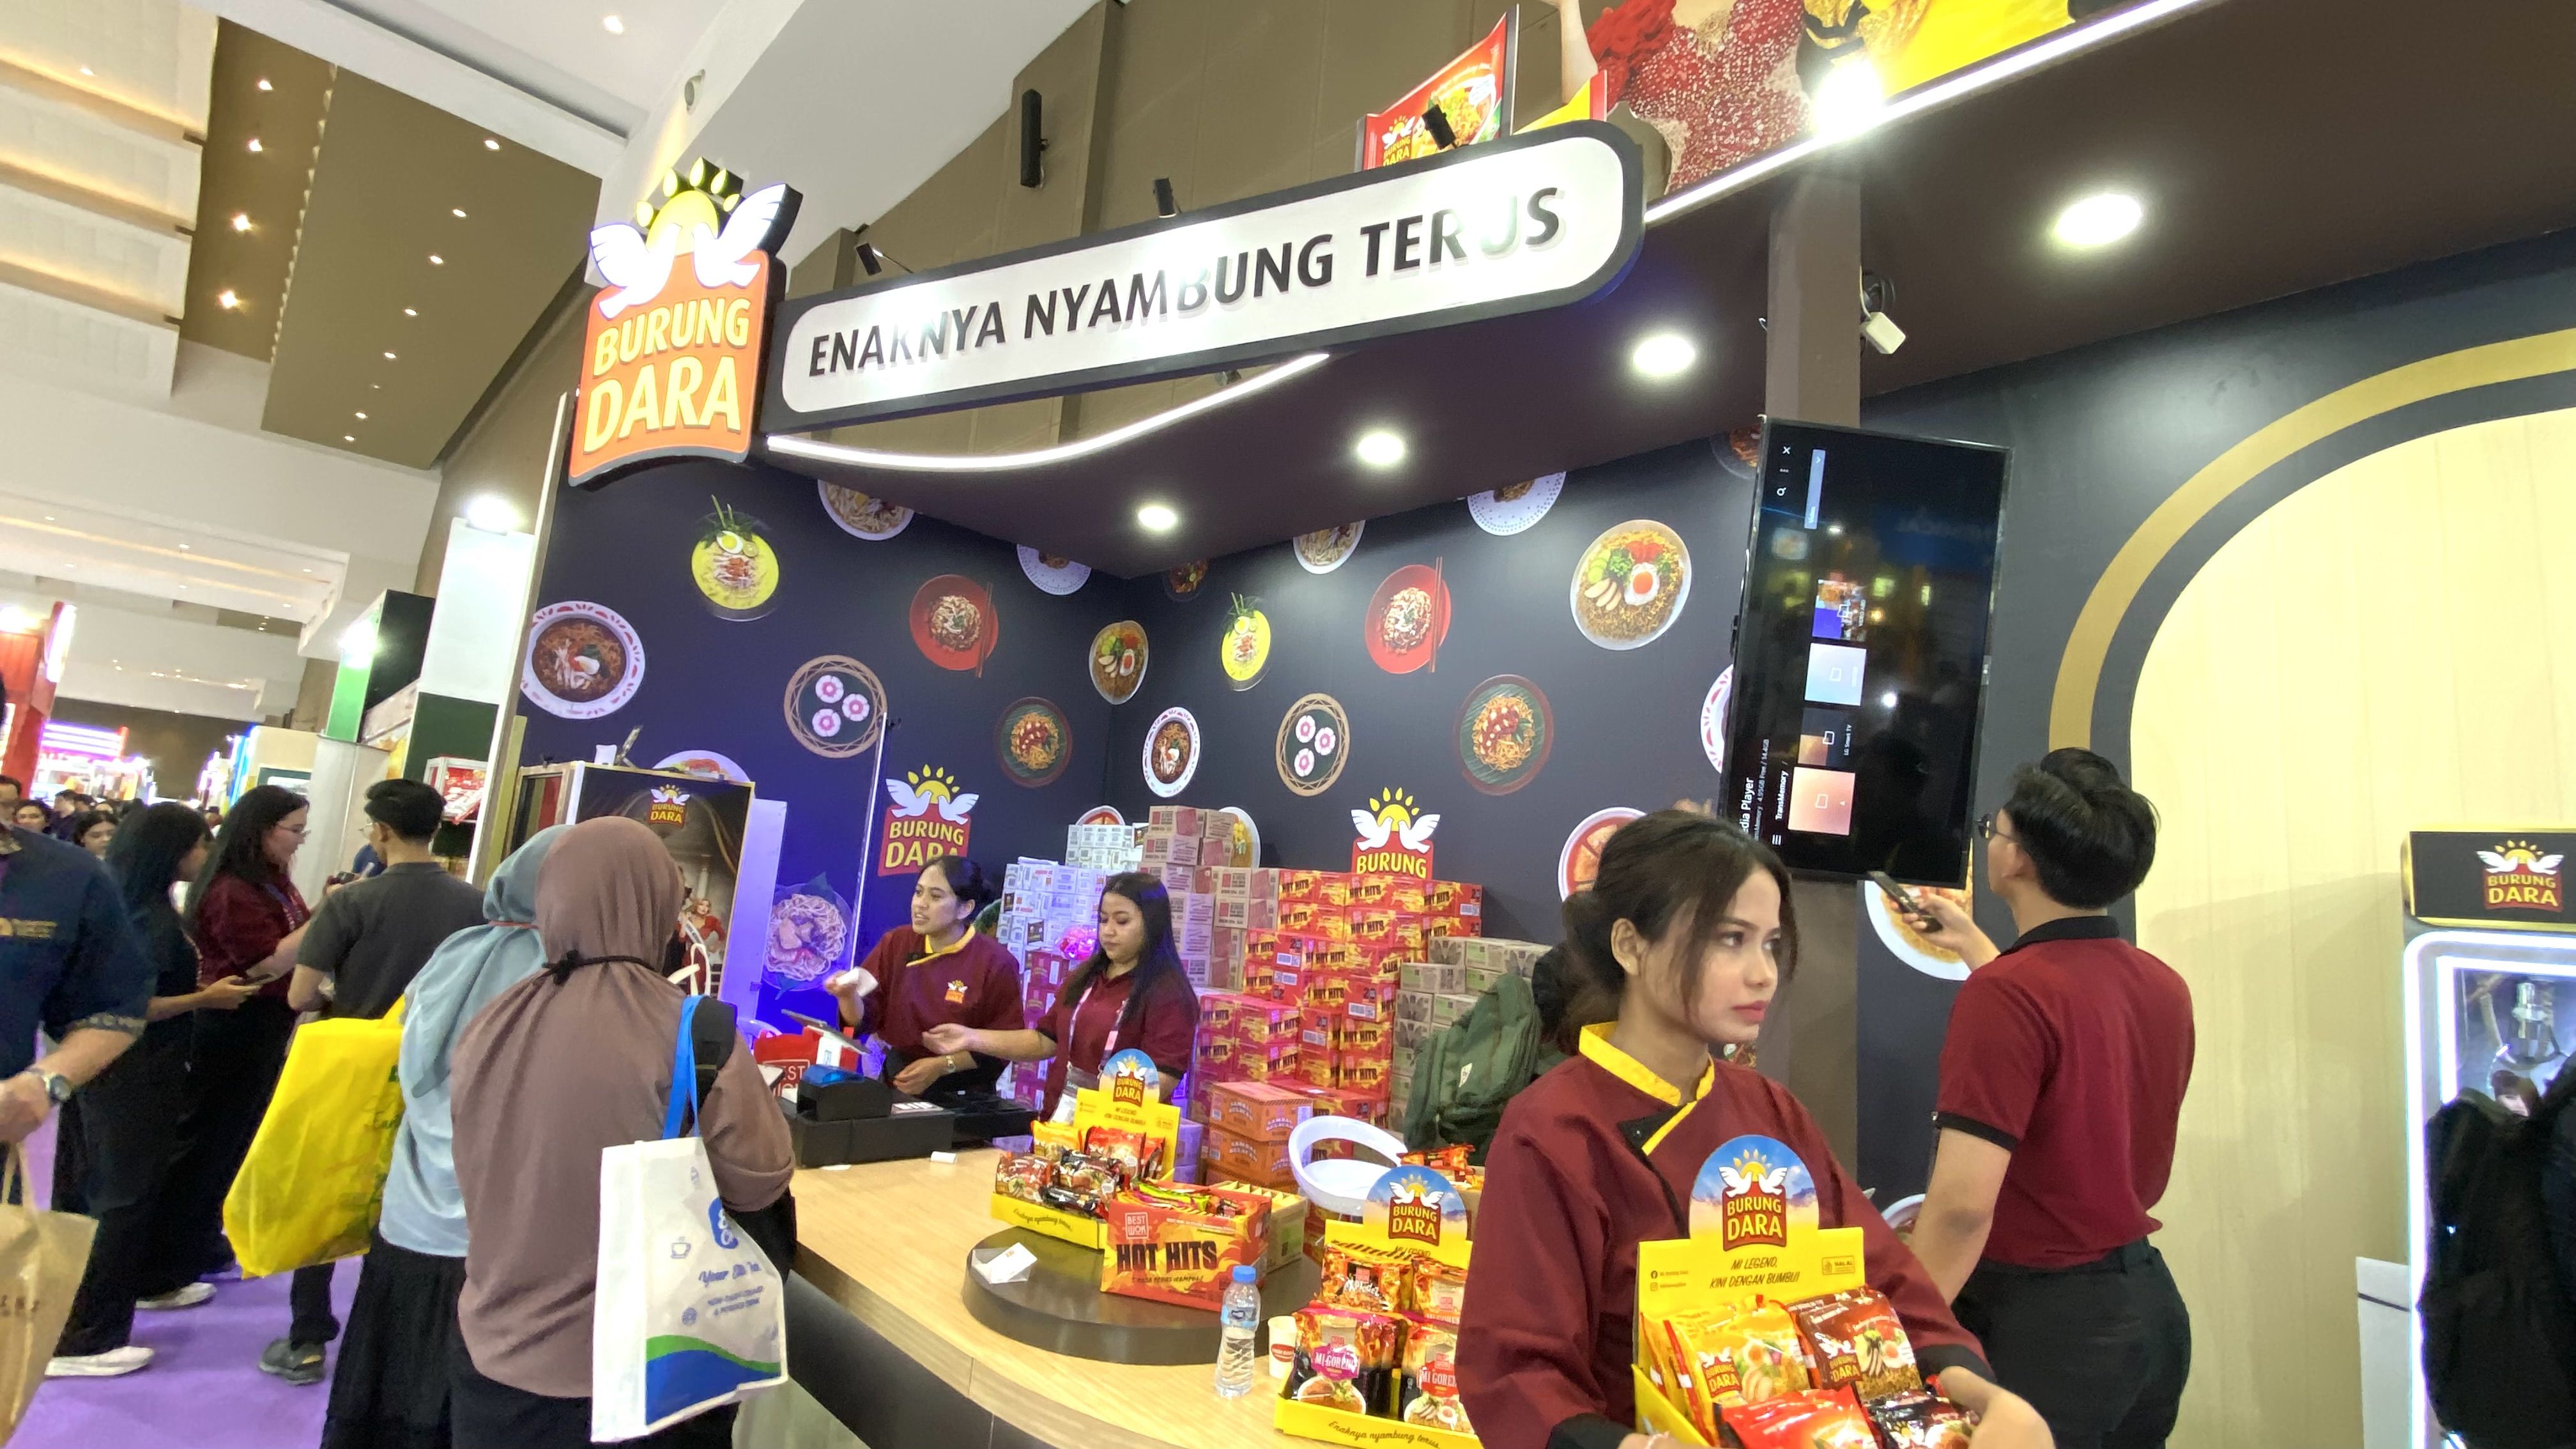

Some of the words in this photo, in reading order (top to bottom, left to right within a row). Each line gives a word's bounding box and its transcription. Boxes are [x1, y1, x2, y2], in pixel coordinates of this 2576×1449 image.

[809, 300, 1006, 377] ENAKNYA
[1023, 233, 1334, 339] NYAMBUNG
[592, 298, 751, 377] BURUNG
[583, 355, 741, 454] DARA
[1740, 777, 1755, 811] Player
[1775, 770, 1789, 820] TransMemory
[650, 811, 683, 824] DARA
[889, 820, 965, 846] BURUNG
[1356, 852, 1427, 879] BURUNG
[2488, 875, 2556, 887] BURUNG
[2488, 887, 2558, 907] DARA
[1116, 1087, 1141, 1102] DARA
[1393, 1206, 1438, 1222] BURUNG
[1727, 1195, 1782, 1215] BURUNG
[1127, 1216, 1146, 1225] BEST
[1128, 1225, 1147, 1236] WOK
[1392, 1218, 1437, 1239] DARA
[1727, 1213, 1784, 1241] DARA
[1116, 1243, 1158, 1275] HOT
[1165, 1240, 1218, 1273] HITS
[1730, 1257, 1744, 1270] MI
[1709, 1276, 1727, 1289] KINI
[1728, 1274, 1764, 1287] DENGAN
[1708, 1373, 1740, 1392] DARA
[1833, 1365, 1860, 1383] DARA
[1369, 1429, 1415, 1443] nyambung
[1416, 1434, 1439, 1449] terus
